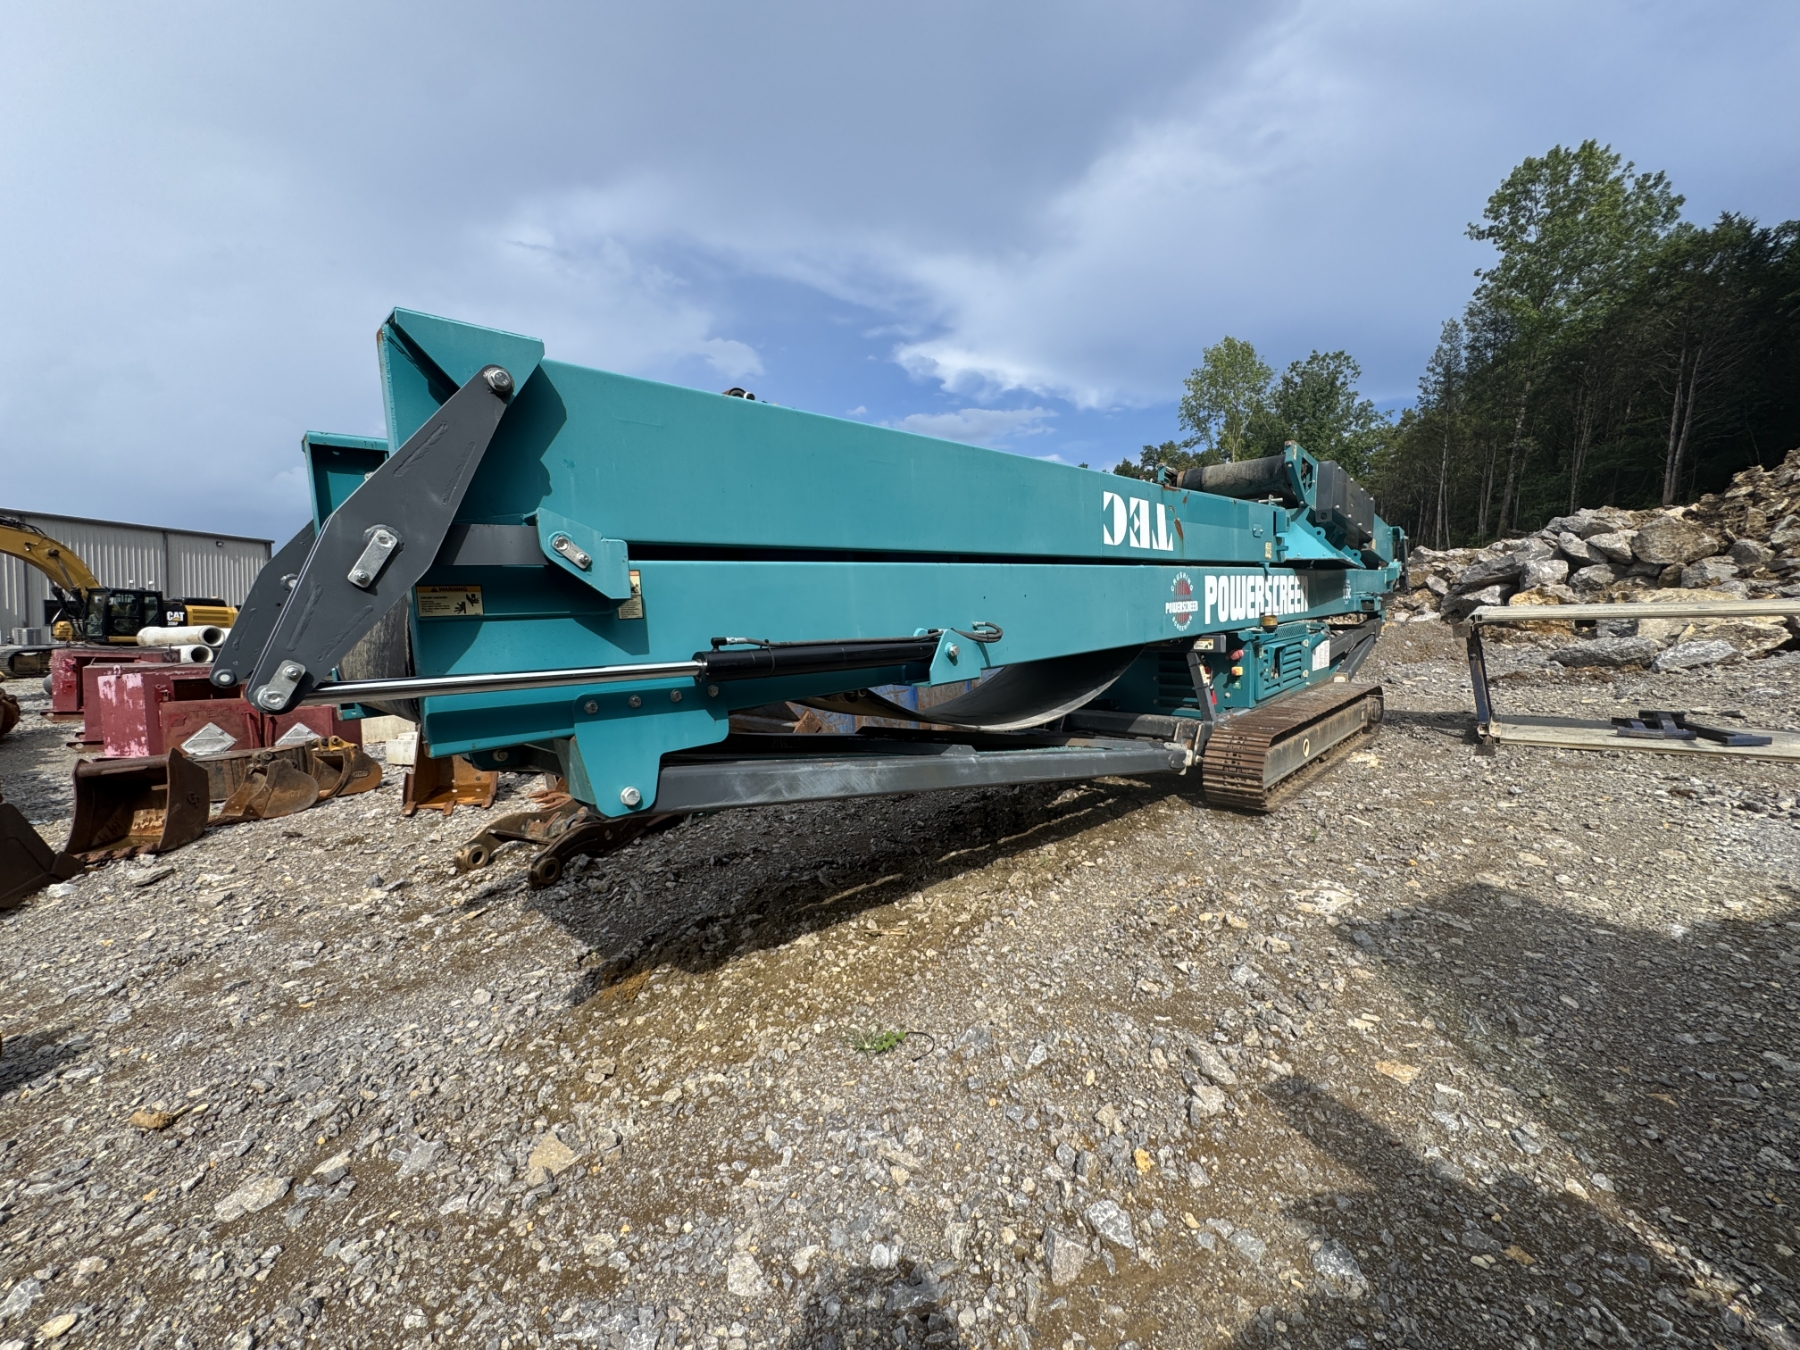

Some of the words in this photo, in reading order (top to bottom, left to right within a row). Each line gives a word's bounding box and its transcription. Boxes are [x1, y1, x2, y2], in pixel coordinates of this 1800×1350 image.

[1204, 574, 1309, 625] POWERSCREEN
[1165, 600, 1199, 614] POWERSCREEN
[166, 611, 185, 622] CAT
